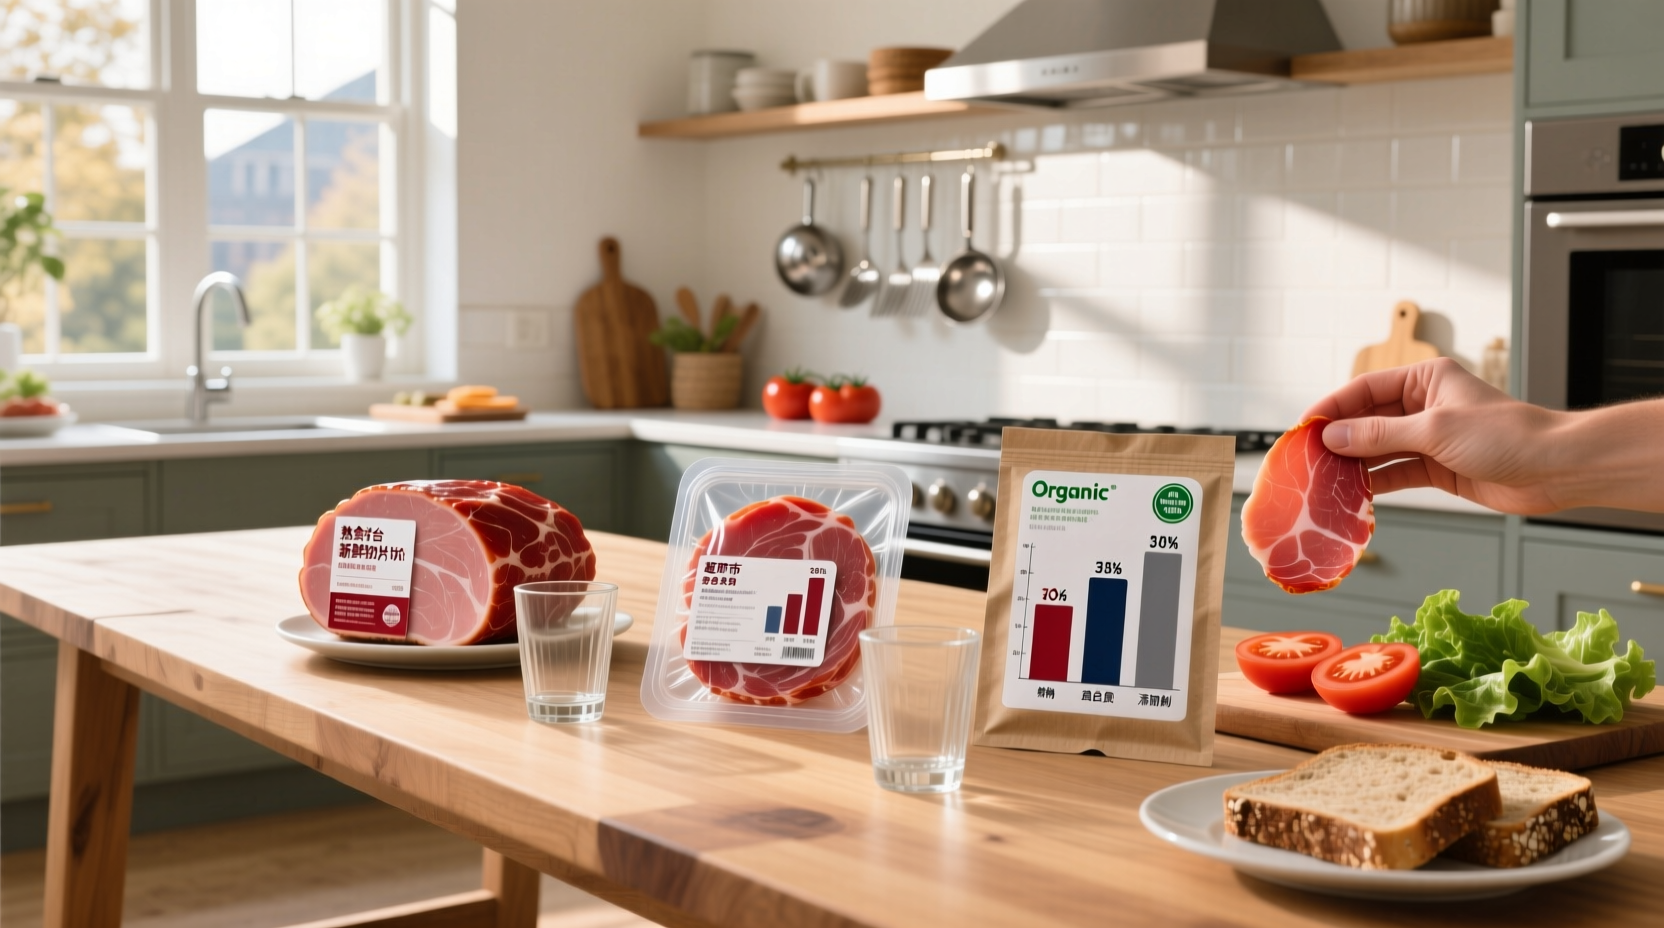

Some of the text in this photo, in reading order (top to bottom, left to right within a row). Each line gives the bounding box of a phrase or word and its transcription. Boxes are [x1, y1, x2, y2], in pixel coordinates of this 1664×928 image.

[1031, 480, 1109, 503] Organic
[1149, 535, 1178, 550] 30%
[1094, 561, 1122, 575] 38%
